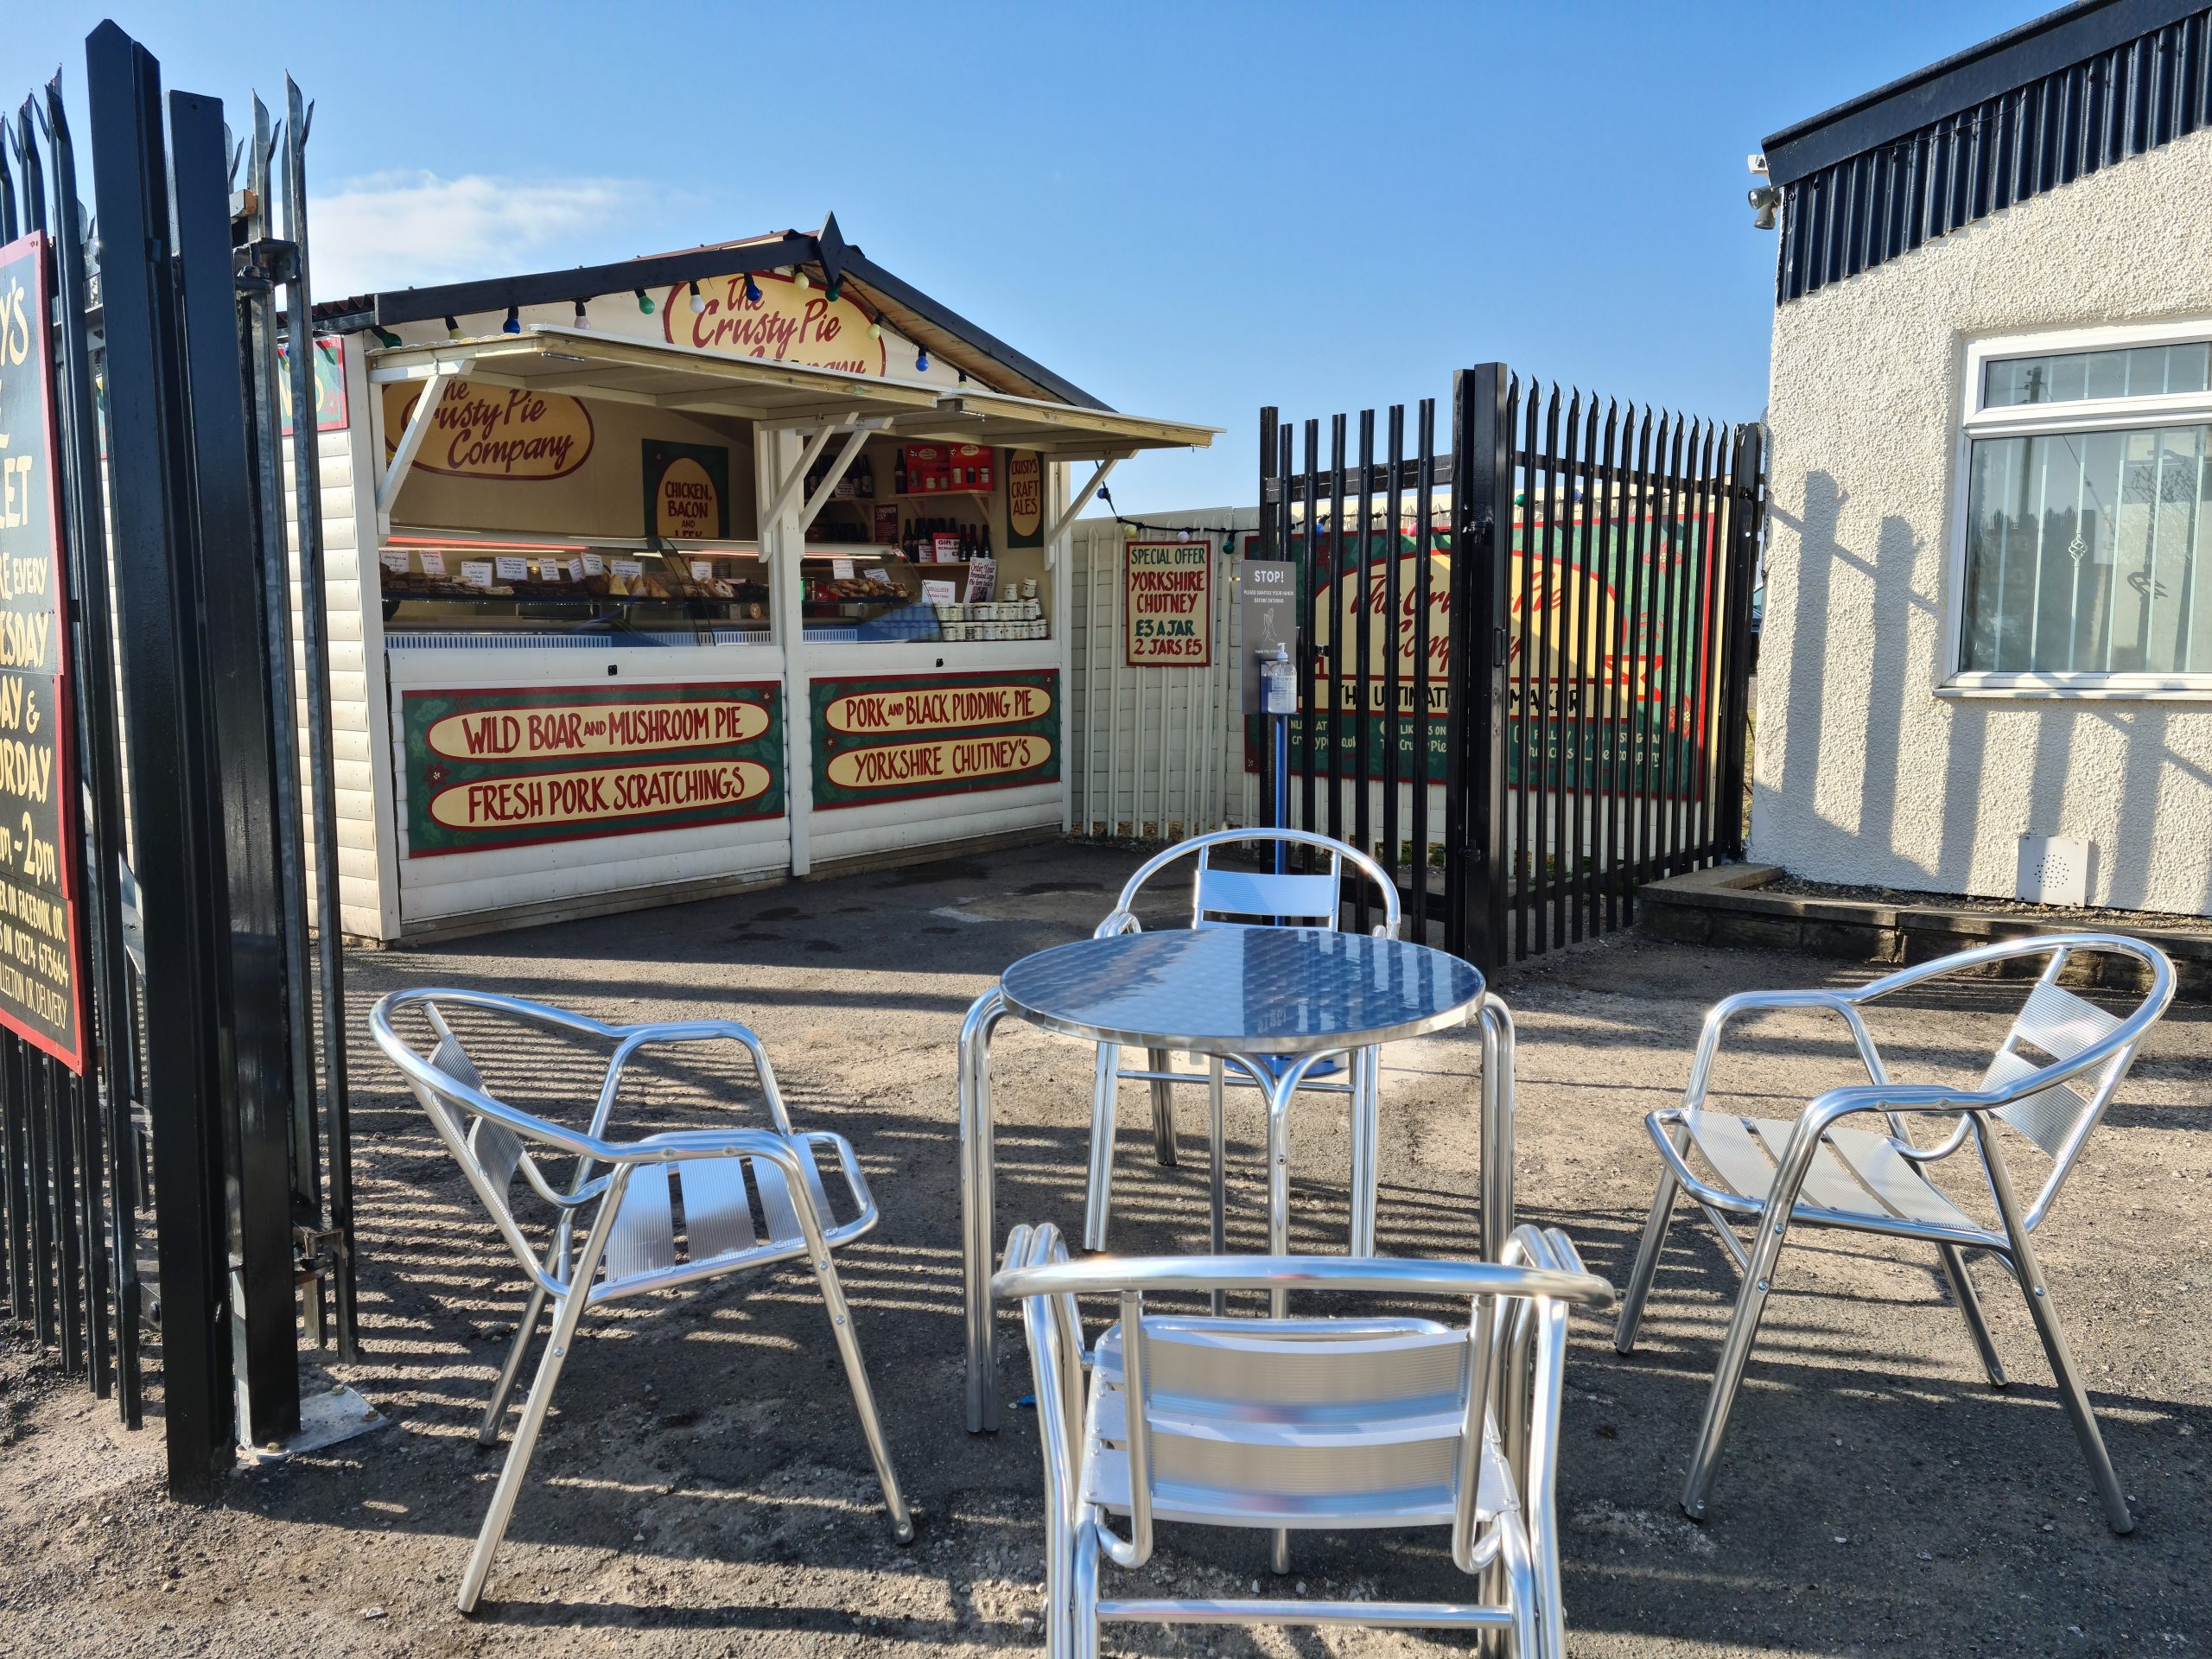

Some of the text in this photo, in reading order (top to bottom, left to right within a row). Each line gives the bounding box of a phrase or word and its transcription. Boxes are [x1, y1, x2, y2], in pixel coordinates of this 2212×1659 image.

[692, 298, 842, 359] Crusty Pie
[442, 380, 471, 401] he
[503, 389, 547, 425] Pie
[448, 429, 575, 474] Company
[0, 455, 33, 529] ET
[664, 480, 713, 501] CHICKEN,
[1011, 480, 1039, 499] CRAFT
[667, 500, 709, 518] BACON
[1013, 499, 1038, 516] ALES
[681, 519, 696, 528] AND
[1131, 546, 1205, 564] SPECIAL OFFER
[13, 556, 48, 595] EVERY
[1131, 570, 1205, 592] YORKSHIRE
[1255, 570, 1284, 582] STOP!
[1136, 593, 1198, 613] CHUTNEY
[1135, 620, 1195, 637] £3 A JAR
[1133, 639, 1203, 655] 2 JARS £5
[0, 674, 41, 734] AY &
[845, 689, 1035, 728] PORK AND BLACK PUDDING PIE
[462, 706, 744, 756] WILD BOAR AND MUSHROOM PIE
[1435, 725, 1446, 736] ON
[854, 737, 1032, 784] YORKSHIRE CHUTNEY'S
[1431, 740, 1447, 753] Pie
[468, 766, 746, 823] FRESH PORK SCRATCHINGS
[0, 825, 13, 866] m
[8, 883, 16, 917] ON
[18, 888, 52, 937] FACEBOOK
[53, 905, 67, 944] OR
[3, 923, 13, 955] ON
[15, 929, 36, 970] 01274
[38, 941, 69, 988] 673664
[26, 976, 36, 1014] OR
[35, 981, 67, 1030] DELIVERY
